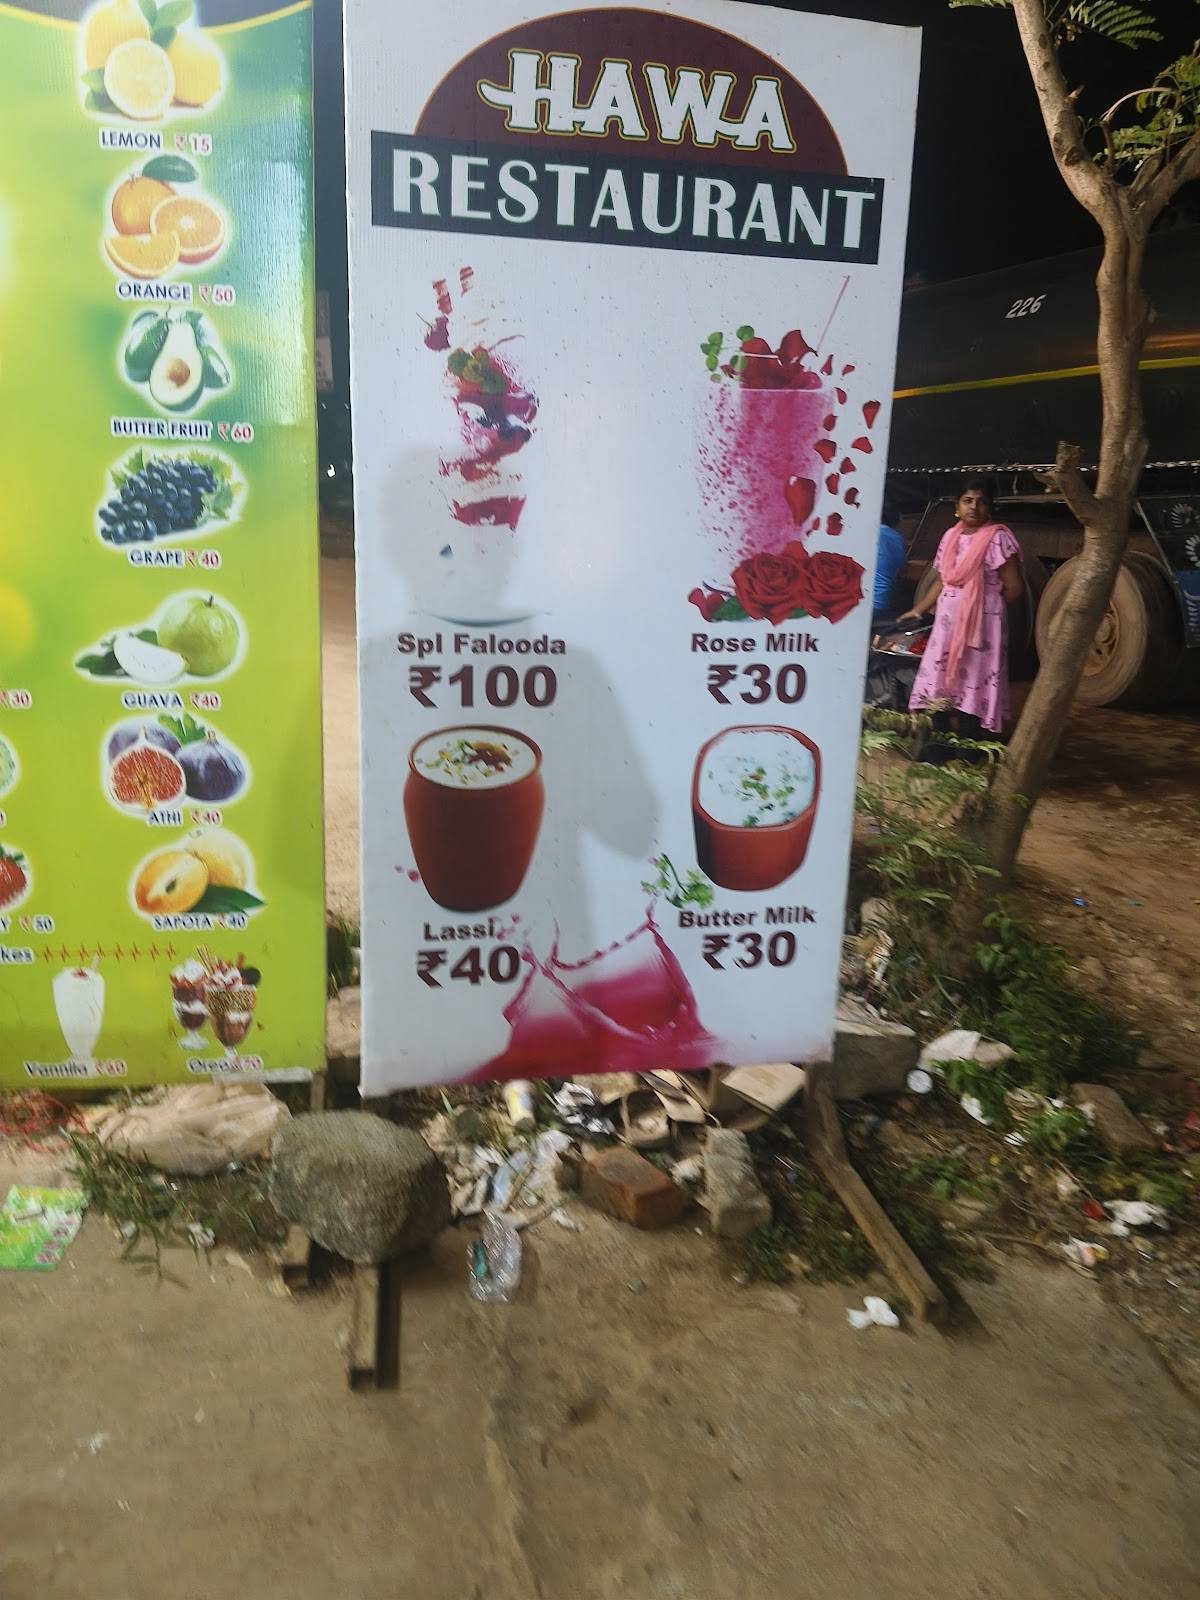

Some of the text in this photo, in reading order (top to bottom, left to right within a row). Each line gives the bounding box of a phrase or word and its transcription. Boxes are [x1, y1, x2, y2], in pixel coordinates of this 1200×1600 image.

[478, 48, 797, 153] HAWA
[102, 131, 161, 149] LEMON
[392, 148, 876, 250] RESTAURANT
[118, 282, 191, 301] ORANGE
[1005, 294, 1047, 319] 226
[112, 420, 165, 438] BUTTER
[170, 421, 212, 439] FRUIT
[130, 551, 184, 567] GRAPE
[397, 632, 566, 659] Spl Falooda
[690, 632, 820, 654] Rose Milk
[407, 664, 559, 709] ₹100
[705, 663, 808, 705] ₹30
[123, 692, 183, 709] GUAVA
[149, 810, 183, 825] ATHI
[153, 914, 213, 930] SAPOTA
[678, 905, 817, 931] Butter Milk
[422, 921, 496, 942] Lassi
[701, 930, 797, 971] ₹30
[416, 944, 521, 989] ₹40
